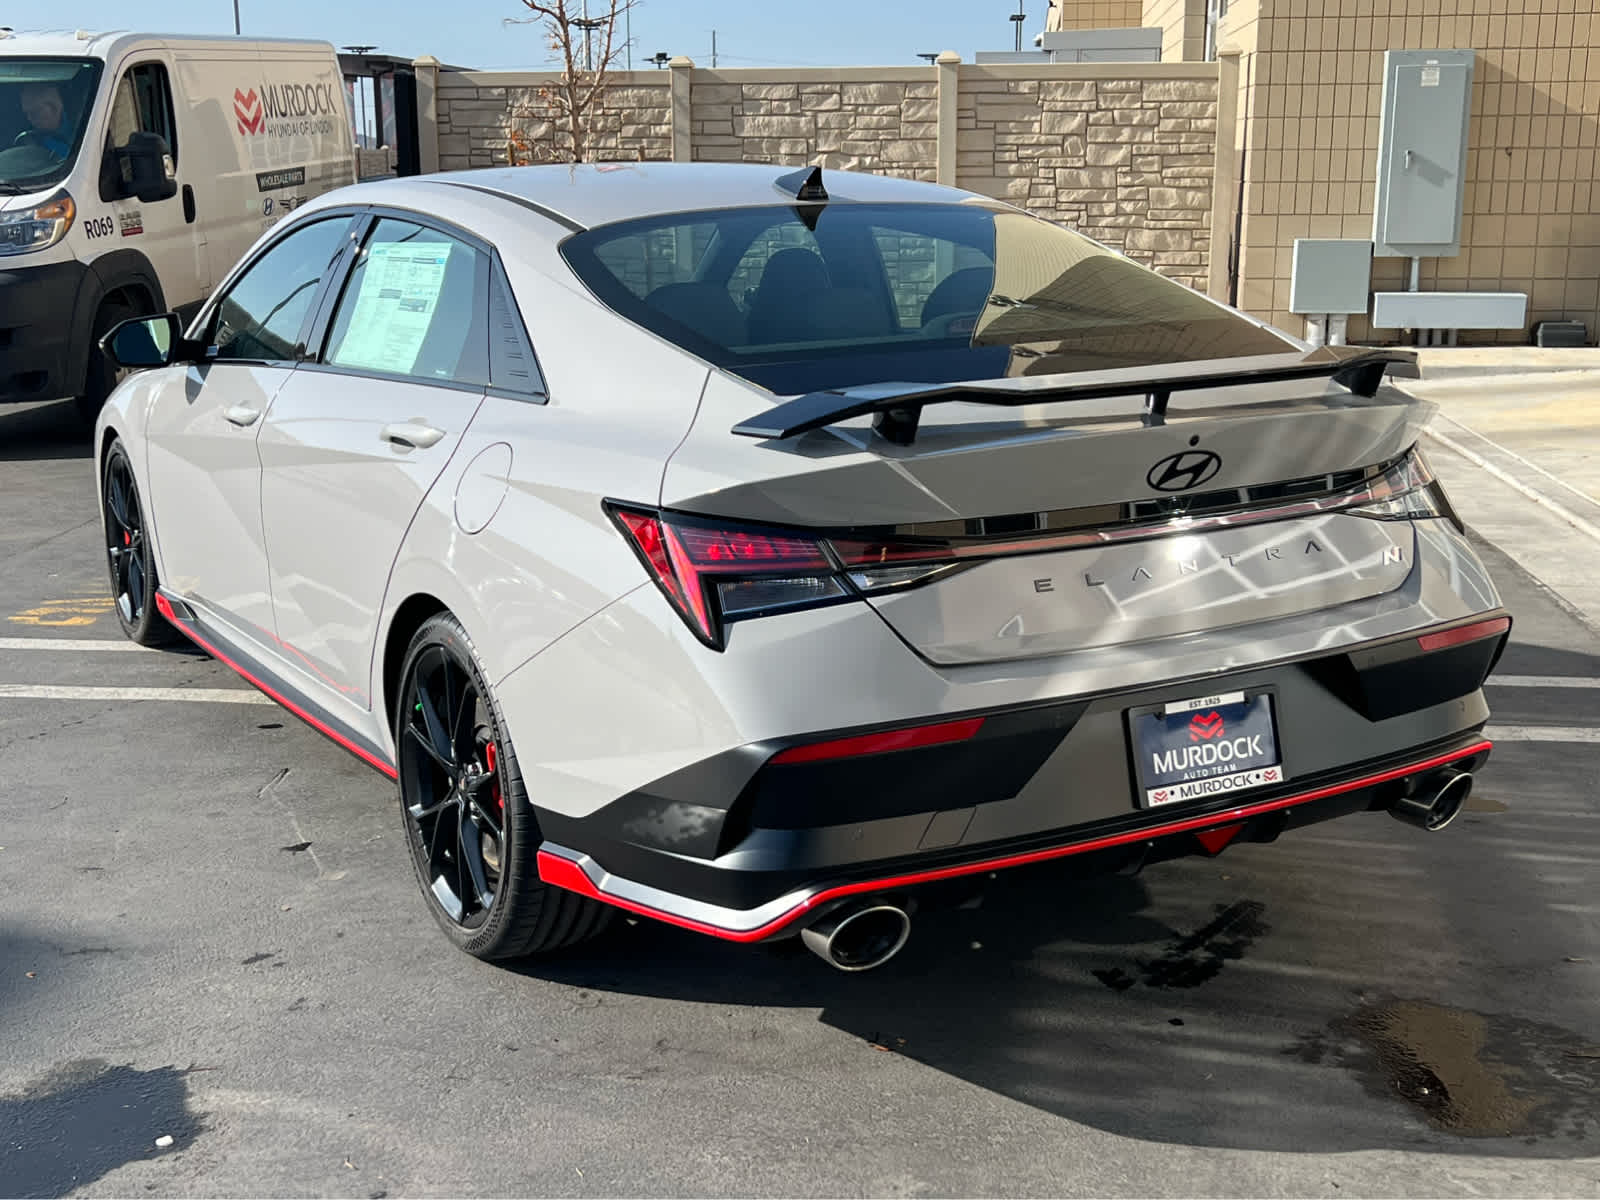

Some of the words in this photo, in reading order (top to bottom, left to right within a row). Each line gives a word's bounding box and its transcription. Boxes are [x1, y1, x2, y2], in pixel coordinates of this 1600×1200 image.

[260, 83, 337, 118] MURDOCK
[268, 122, 299, 138] HYUNDAI
[300, 121, 309, 136] OF
[84, 216, 114, 239] R069
[1034, 540, 1322, 593] ELANTRA
[1382, 546, 1402, 566] N
[1153, 734, 1263, 774] MURDOCK
[1183, 768, 1209, 780] AUTO
[1213, 764, 1237, 775] TEAM
[1180, 774, 1253, 798] MURDOCK
